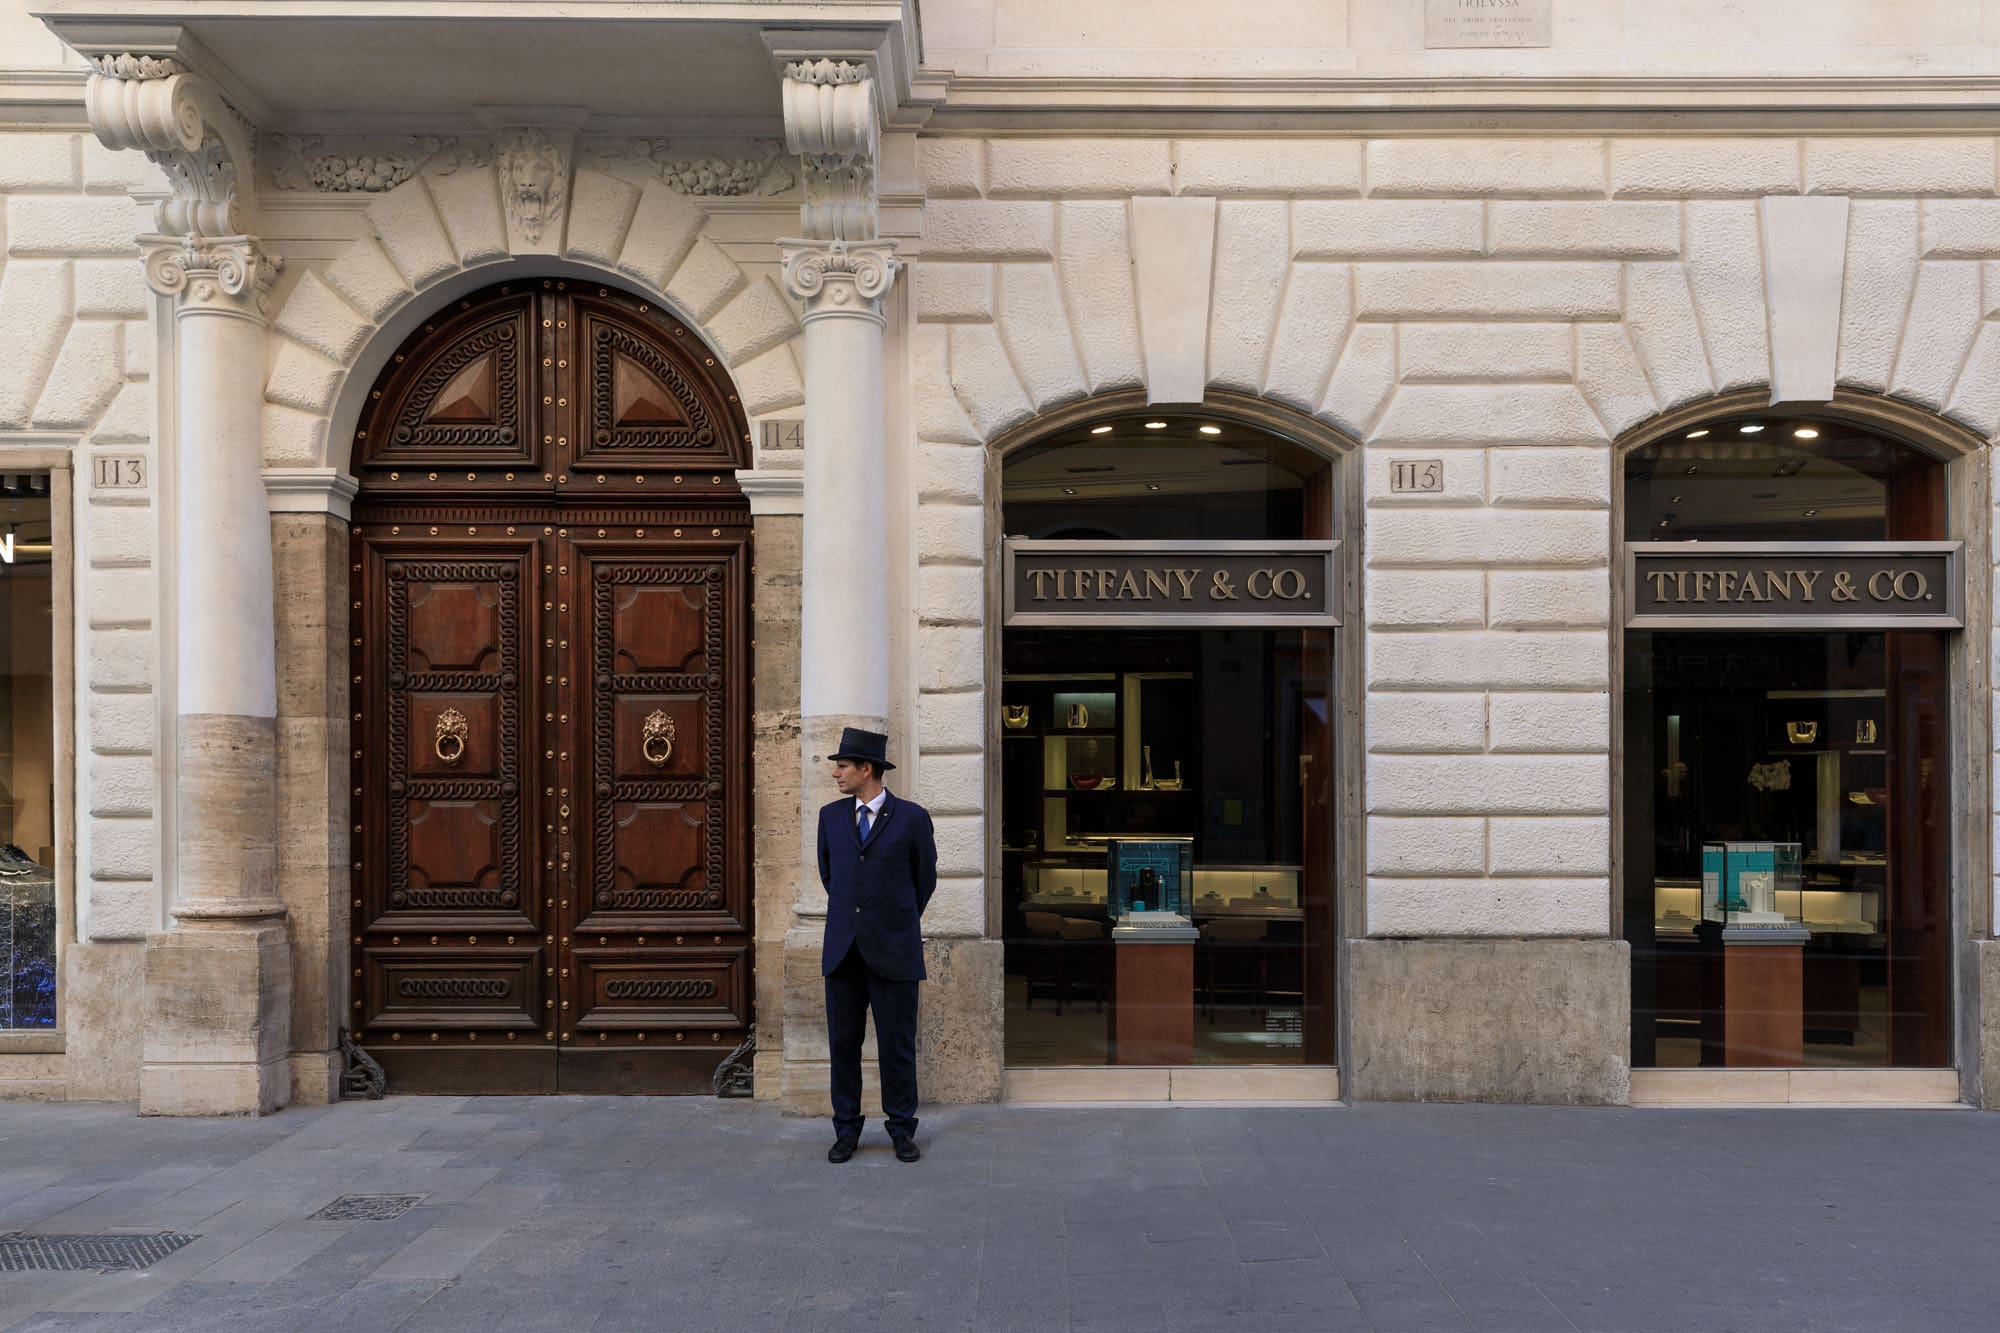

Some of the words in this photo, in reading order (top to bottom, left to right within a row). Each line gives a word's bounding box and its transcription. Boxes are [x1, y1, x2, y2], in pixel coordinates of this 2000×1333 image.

[765, 423, 804, 447] 114
[100, 460, 141, 485] 113
[1397, 464, 1437, 489] 115
[1026, 569, 1202, 600] TIFFANY
[1209, 569, 1239, 600] &
[1247, 568, 1311, 600] CO.
[1647, 570, 1824, 602] TIFFANY
[1830, 570, 1859, 601] &
[1868, 569, 1932, 601] CO.
